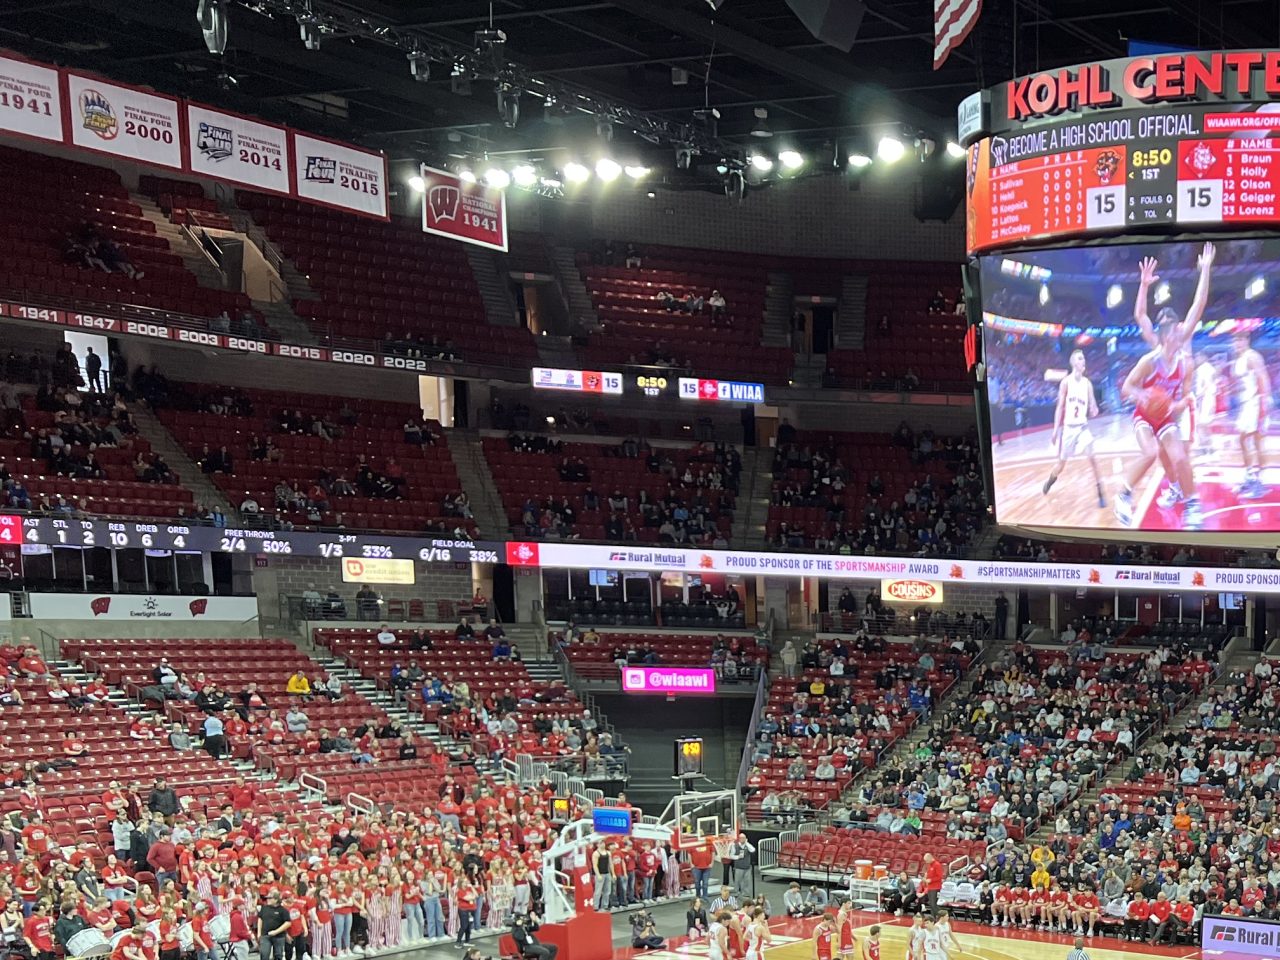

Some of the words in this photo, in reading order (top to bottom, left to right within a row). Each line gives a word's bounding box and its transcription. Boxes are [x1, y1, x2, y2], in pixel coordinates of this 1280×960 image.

[1007, 63, 1114, 119] KOHL
[0, 92, 52, 116] 1941
[124, 111, 148, 123] FINAL
[150, 117, 172, 128] FOUR
[125, 121, 173, 144] 2000
[1010, 130, 1048, 158] BECOME
[1050, 129, 1058, 150] A
[1061, 126, 1086, 147] HIGH
[1088, 119, 1134, 144] SCHOOL
[1138, 114, 1200, 138] OFFICIAL.
[1240, 139, 1272, 149] NAME
[239, 149, 282, 171] 2014
[1132, 149, 1171, 167] 8:50
[1241, 154, 1272, 163] Braun
[339, 166, 378, 182] FINALIST
[1142, 169, 1160, 180] 1ST
[1241, 167, 1267, 178] Holly
[340, 175, 379, 196] 2015
[1224, 180, 1235, 189] 12
[1240, 180, 1271, 189] Olson
[1095, 193, 1115, 214] 15
[1140, 195, 1162, 205] FOULS
[1187, 187, 1212, 208] 15
[1223, 193, 1235, 202] 24
[1240, 193, 1275, 204] Geiger
[1223, 206, 1235, 215] 33
[1239, 206, 1275, 215] Lorenz
[464, 213, 497, 232] 1941
[19, 306, 58, 322] 1941
[75, 314, 115, 330] 1947
[127, 322, 169, 338] 2002
[179, 330, 218, 346] 2003
[228, 337, 267, 354] 2008
[279, 344, 321, 360] 2015
[332, 350, 375, 366] 2020
[383, 356, 427, 372] 2022
[605, 378, 618, 388] 15
[636, 376, 667, 388] 8:50
[683, 383, 696, 394] 15
[731, 384, 762, 400] WIAA
[1, 528, 12, 540] 4
[23, 518, 40, 527] AST
[53, 520, 68, 528] STL
[80, 521, 93, 529] TO
[108, 523, 125, 531] REB
[136, 524, 158, 532] DREB
[167, 526, 189, 535] OREB
[224, 529, 243, 537] FREE
[244, 530, 274, 539] THROWS
[26, 528, 38, 541] 4
[57, 530, 66, 543] 1
[83, 531, 94, 544] 2
[109, 532, 128, 546] 10
[142, 534, 153, 546] 6
[174, 535, 185, 548] 4
[221, 538, 246, 551] 2/4
[263, 540, 291, 553] 50%
[432, 540, 452, 548] FIELD
[454, 540, 475, 549] GOAL
[319, 543, 342, 556] 1/3
[363, 545, 392, 558] 33%
[420, 547, 450, 561] 6/16
[469, 550, 497, 562] 38%
[628, 552, 653, 562] Rural
[654, 553, 686, 563] Mutual
[726, 556, 757, 567] PROUD
[760, 557, 800, 568] SPONSOR
[803, 558, 814, 569] OF
[816, 559, 832, 570] THE
[835, 560, 906, 573] SPORTSMANSHIP
[908, 564, 939, 575] AWARD
[977, 566, 1081, 579] #SPORTSMANSHIPMATTERS
[1131, 570, 1151, 581] Rural
[1153, 571, 1180, 581] Mutual
[1215, 573, 1244, 584] PROUD
[891, 583, 933, 597] COUSINS
[649, 673, 708, 688] @wiaawi
[1238, 928, 1273, 946] Rural
